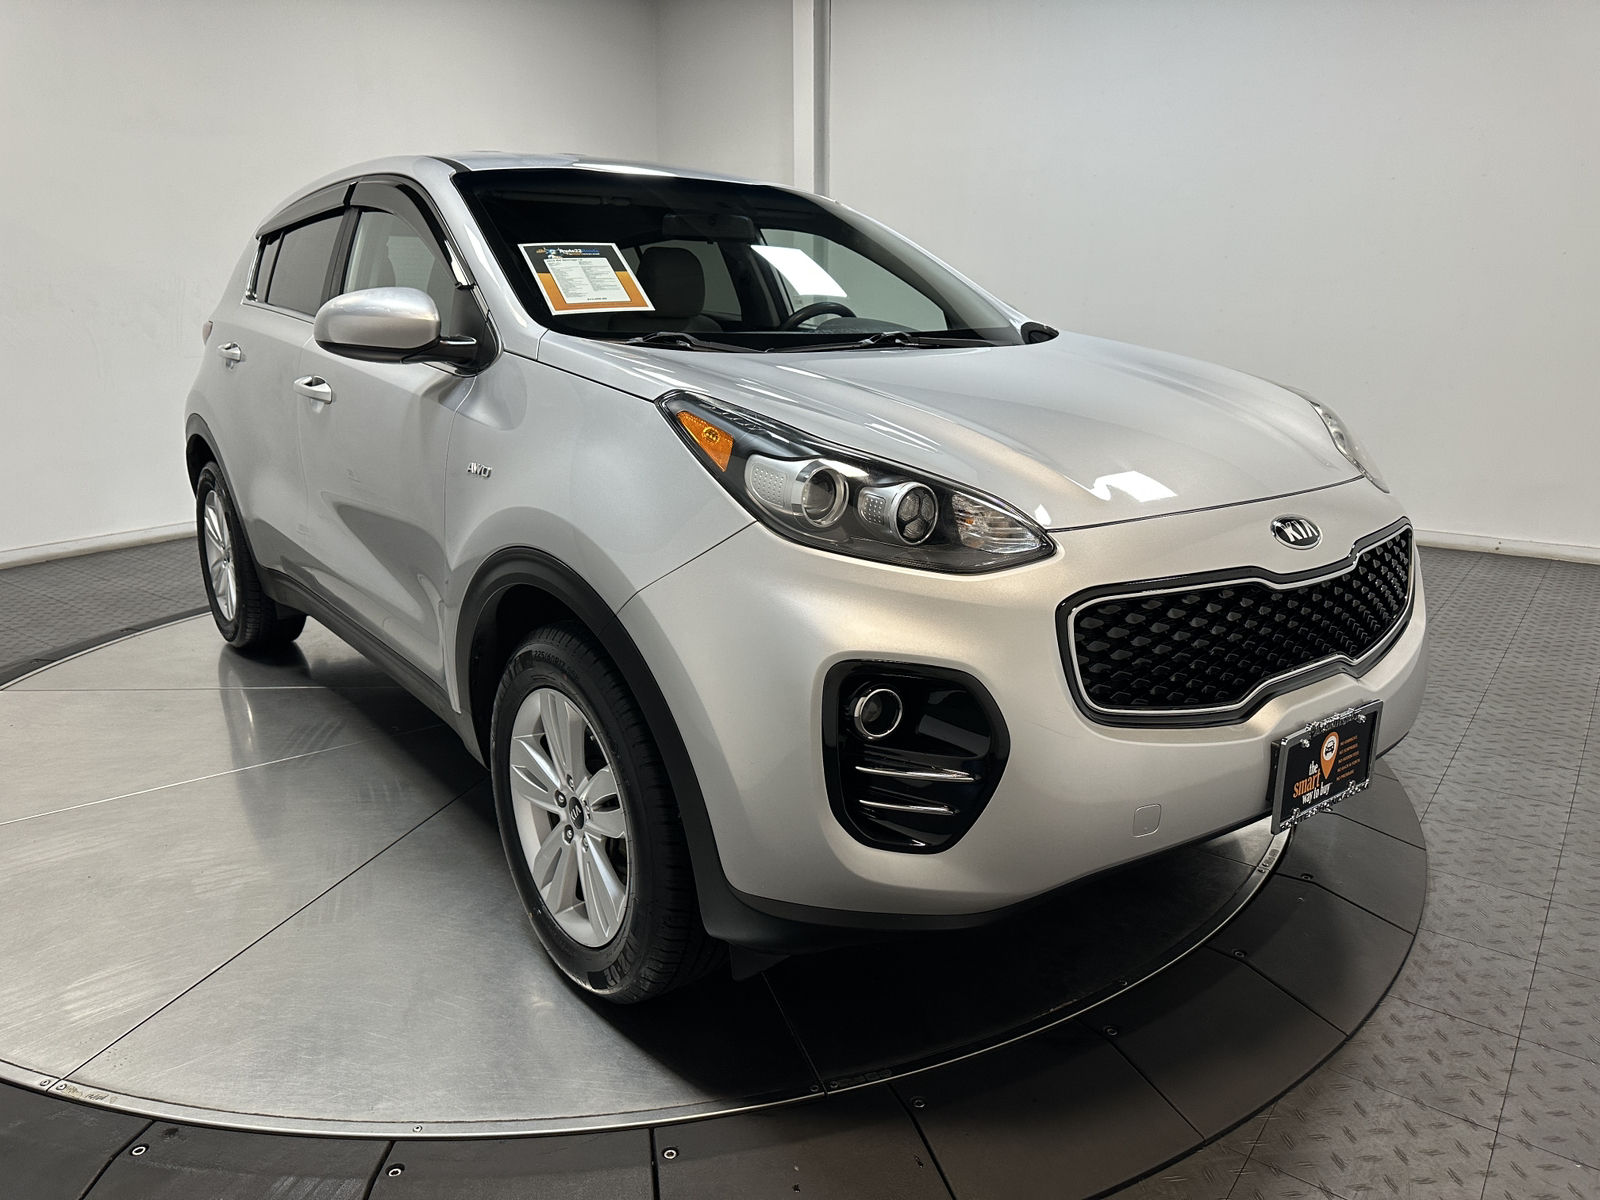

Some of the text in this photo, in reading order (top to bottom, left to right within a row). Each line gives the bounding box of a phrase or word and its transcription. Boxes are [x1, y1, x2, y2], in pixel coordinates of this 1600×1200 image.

[467, 462, 492, 478] AWD
[1280, 519, 1319, 542] KIA
[1309, 760, 1319, 776] the
[1293, 768, 1321, 798] smart
[1302, 781, 1331, 805] way to buy
